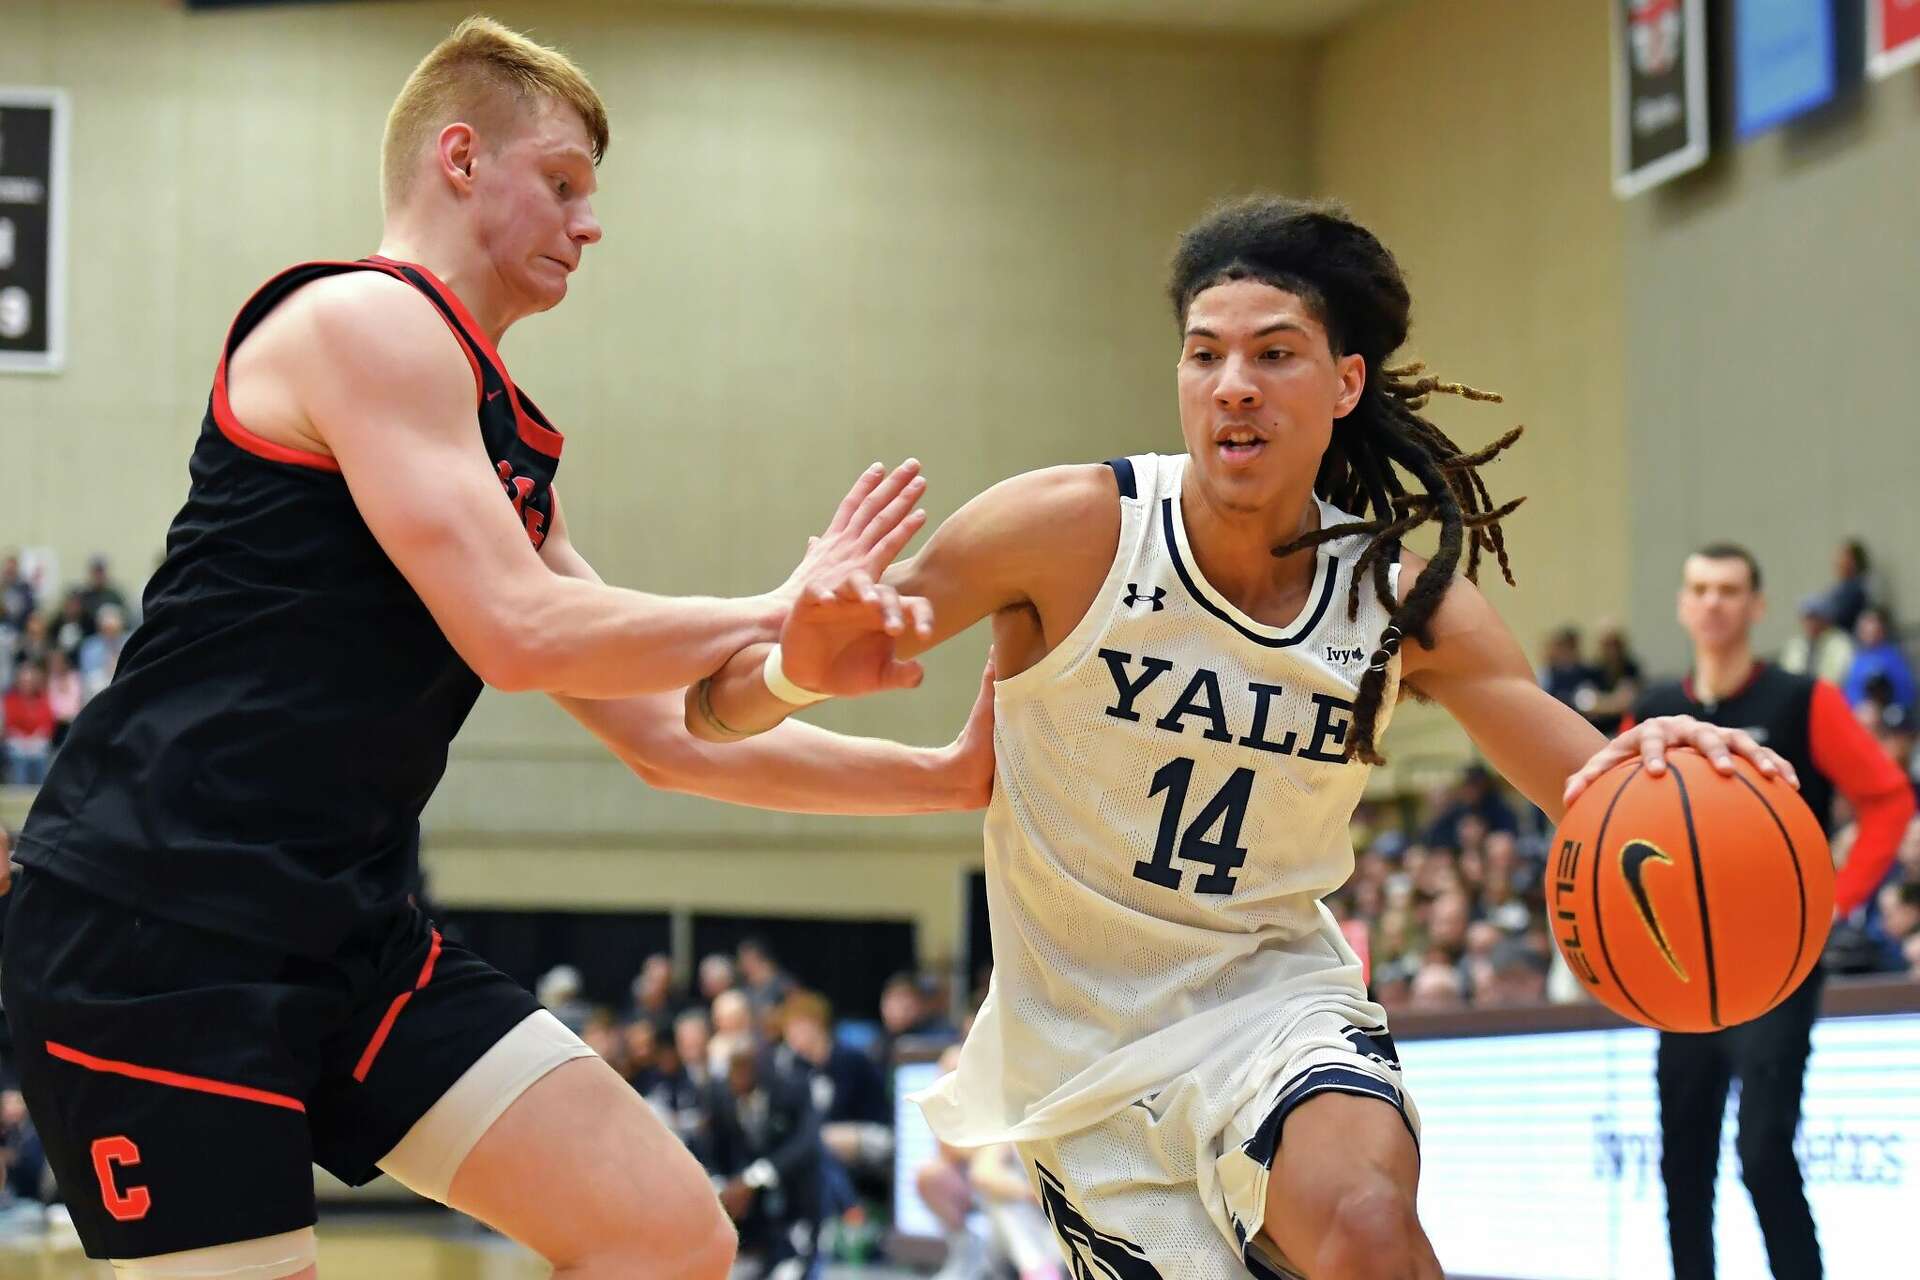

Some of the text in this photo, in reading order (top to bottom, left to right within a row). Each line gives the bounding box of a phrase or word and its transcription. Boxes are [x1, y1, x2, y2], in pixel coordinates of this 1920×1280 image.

[1098, 648, 1354, 764] YALE
[1326, 646, 1351, 665] Ivy
[1132, 757, 1256, 895] 14
[1556, 840, 1600, 984] ELITE
[91, 1135, 151, 1221] C
